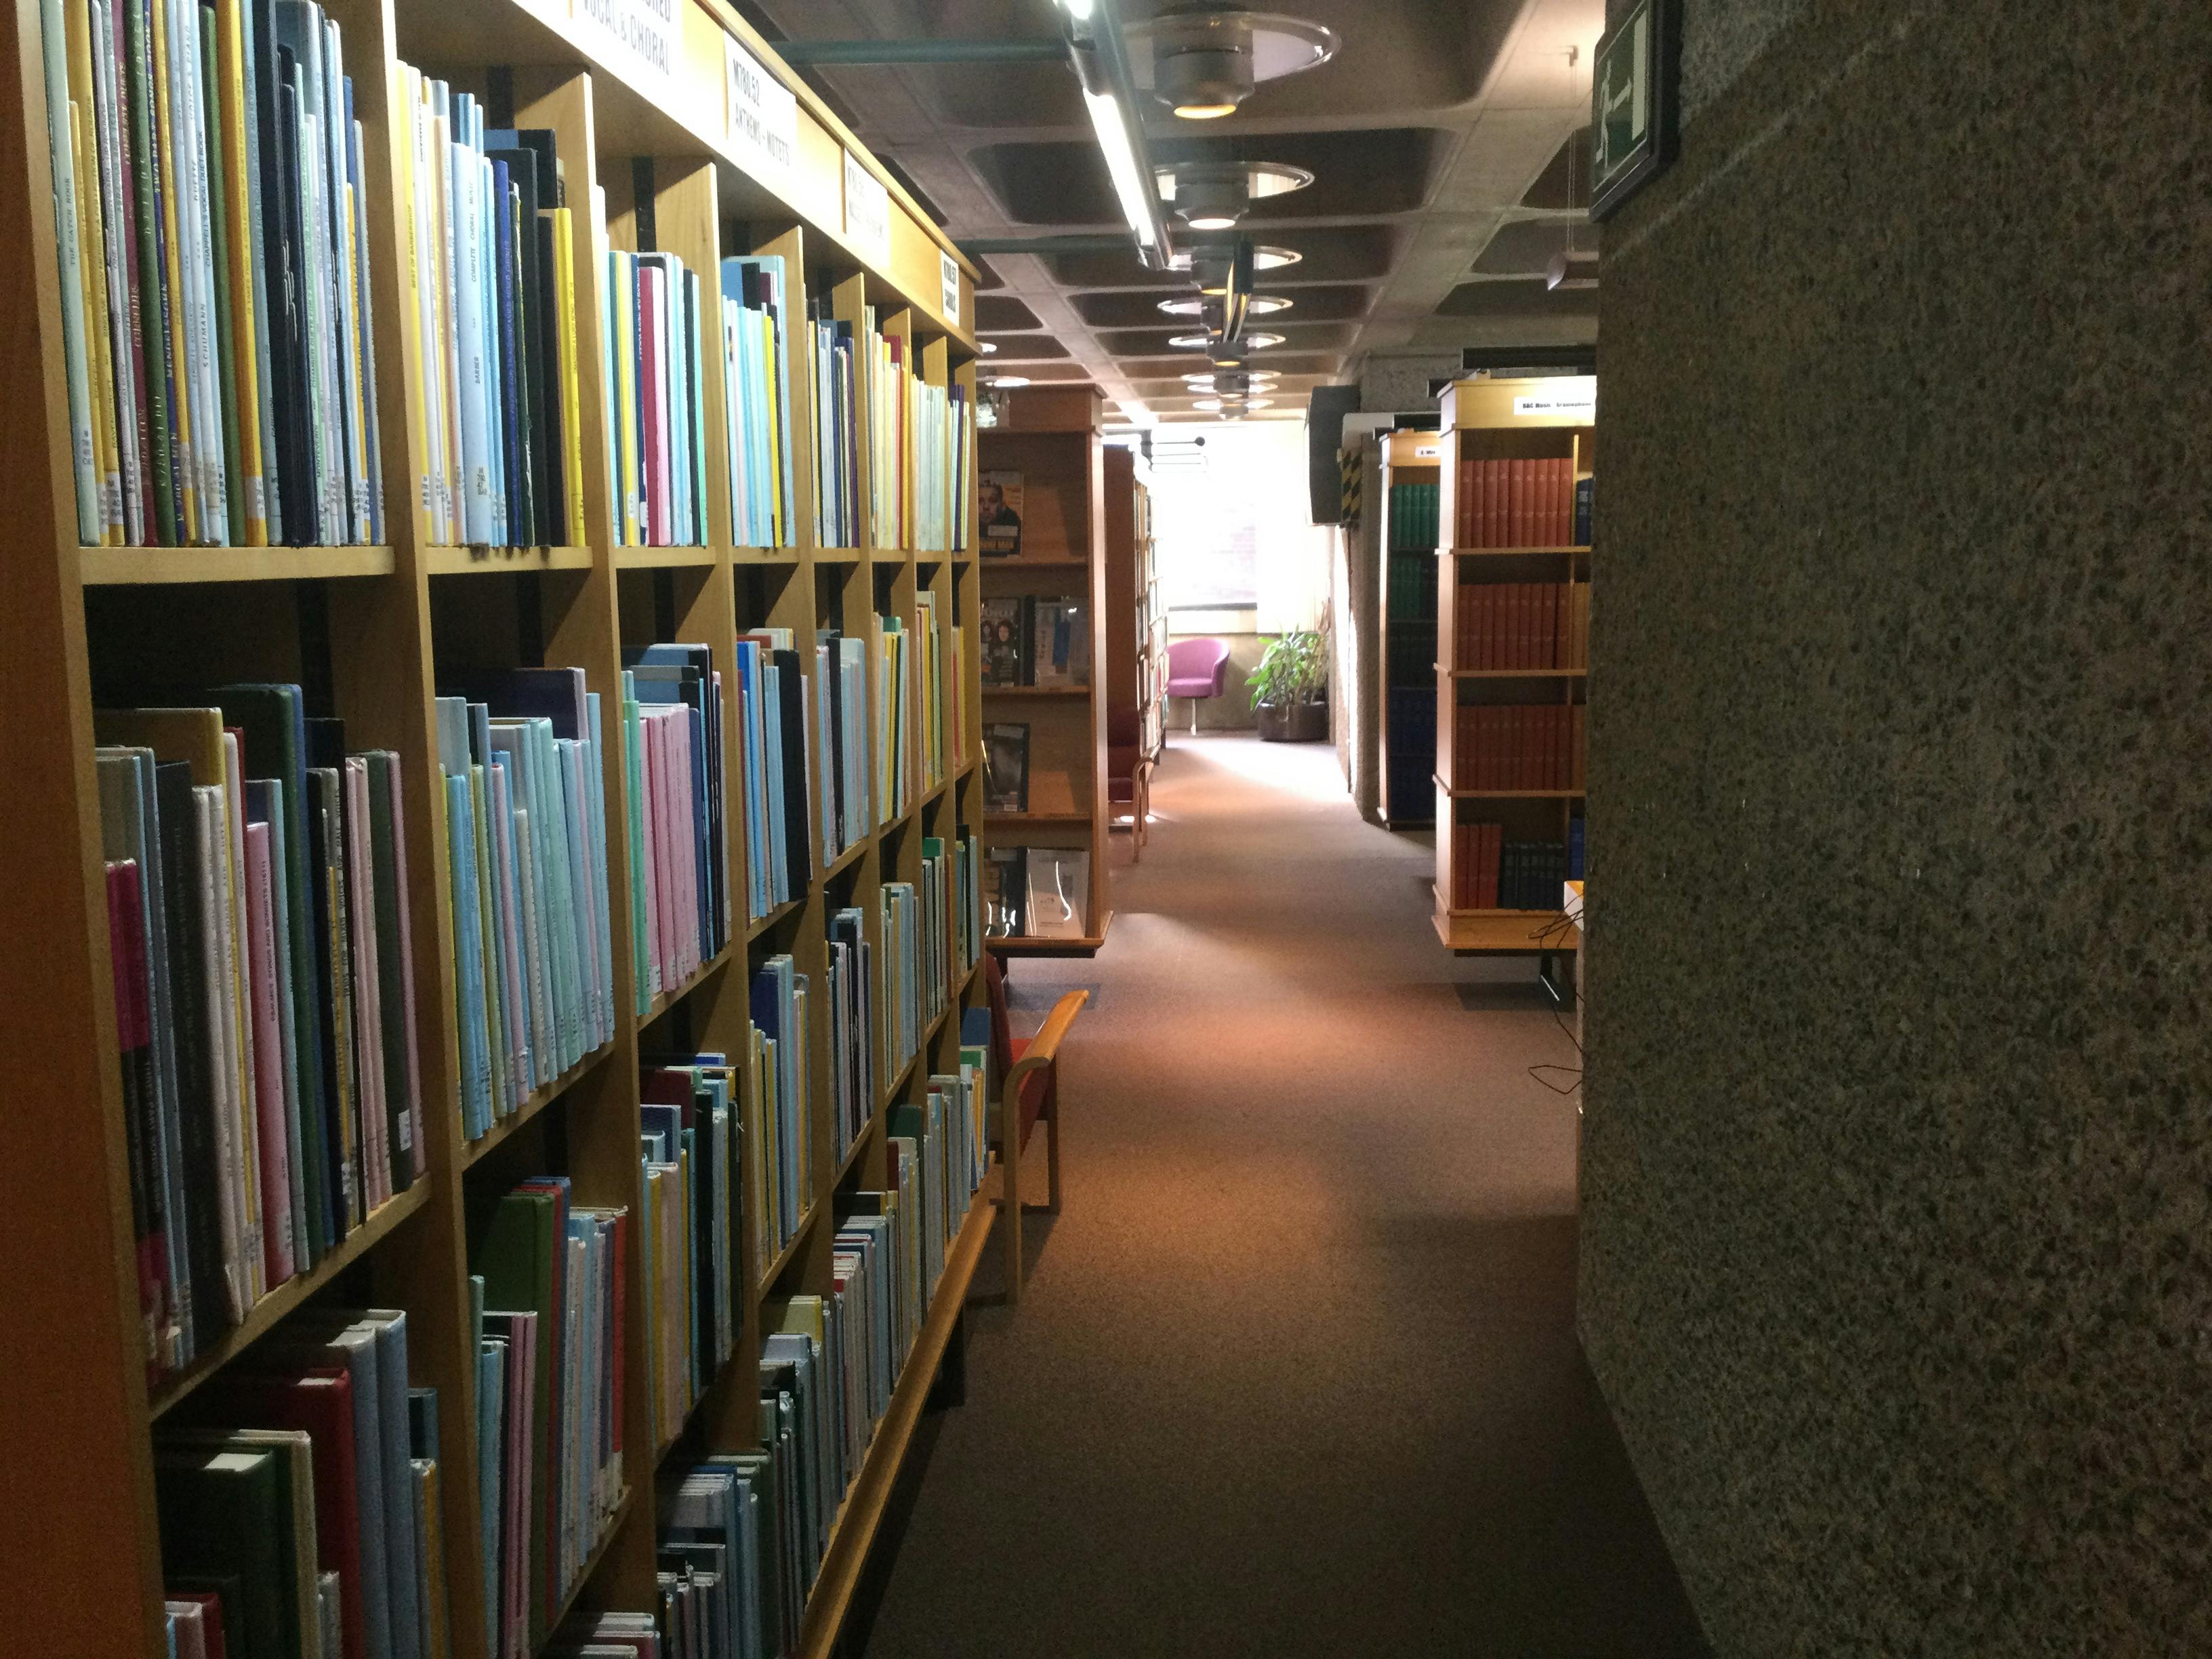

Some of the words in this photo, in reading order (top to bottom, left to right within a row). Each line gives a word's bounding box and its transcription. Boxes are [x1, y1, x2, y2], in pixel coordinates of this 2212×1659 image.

[630, 14, 670, 75] CHORAL
[735, 102, 760, 146] ANTHEMS
[766, 129, 790, 167] MOTETS
[153, 163, 161, 193] TWO
[411, 258, 415, 267] OF
[161, 283, 173, 377] MENDELSSOHN
[201, 303, 209, 367] SCHUMANN
